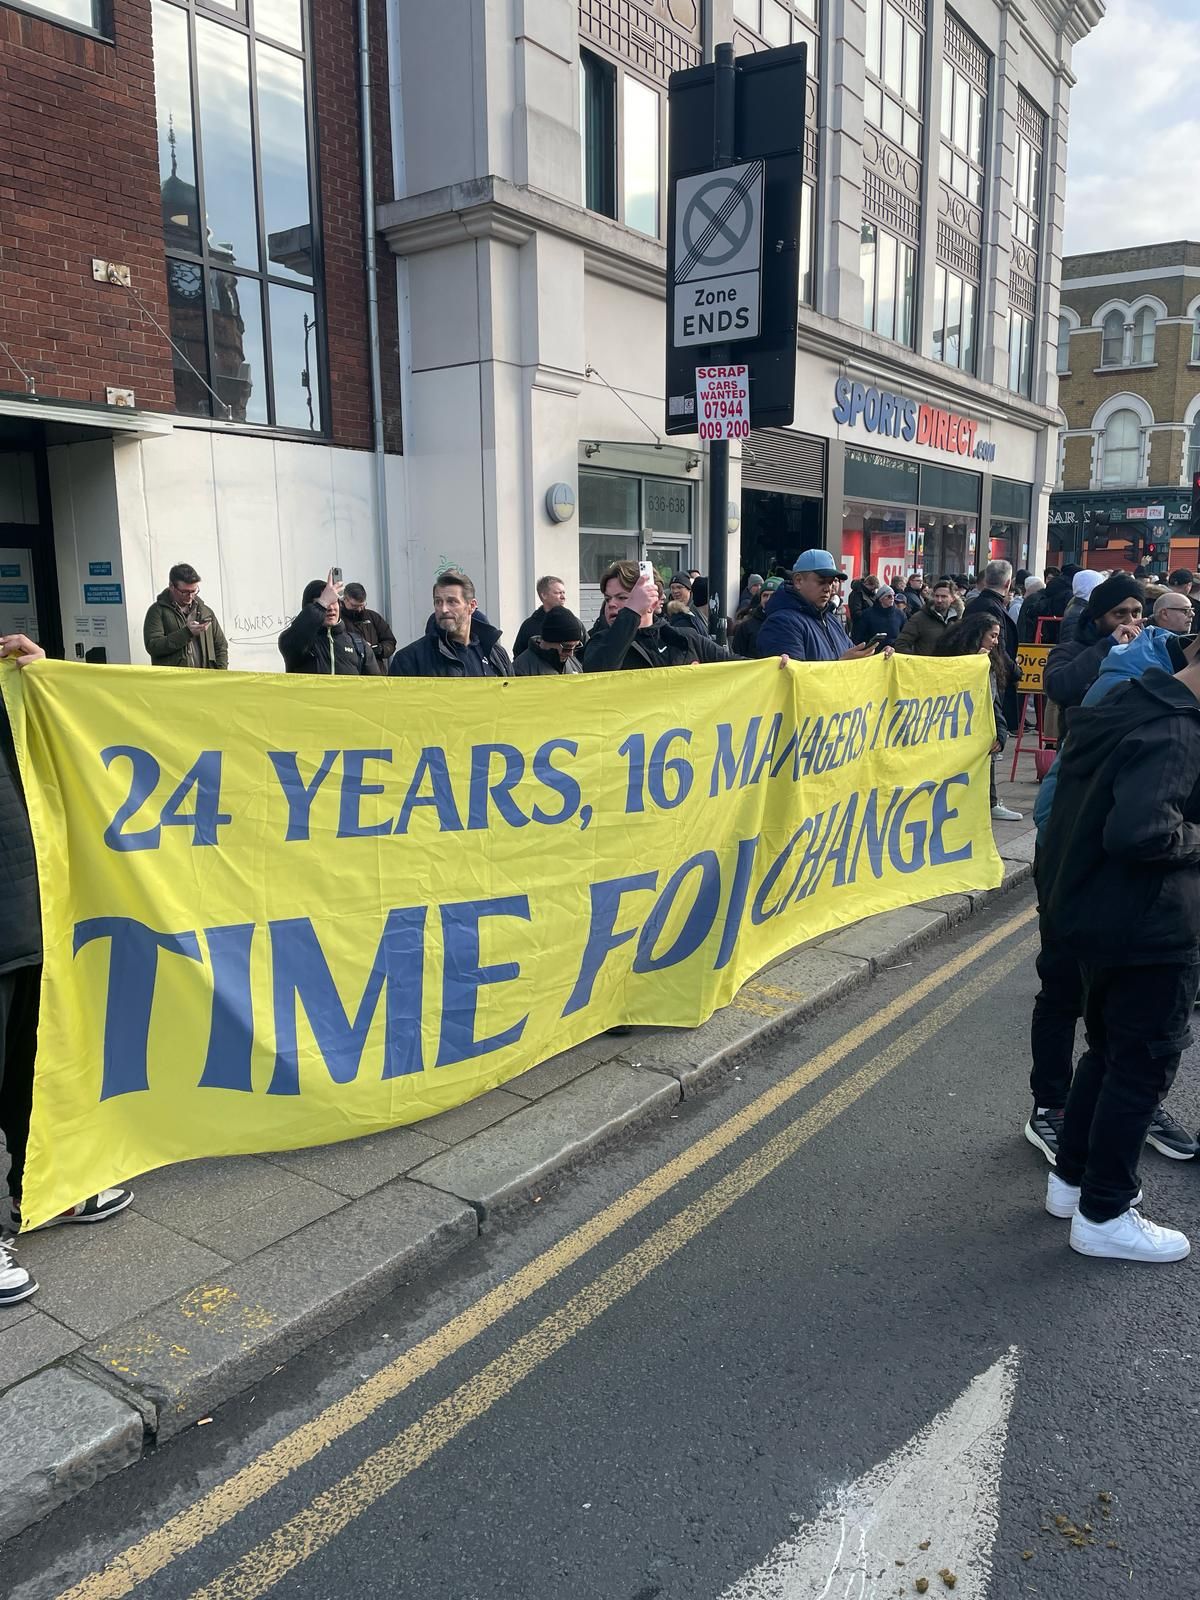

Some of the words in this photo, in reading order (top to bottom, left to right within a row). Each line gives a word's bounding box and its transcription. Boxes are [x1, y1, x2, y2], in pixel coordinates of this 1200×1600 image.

[695, 288, 737, 307] Zone
[683, 307, 750, 337] ENDS
[697, 366, 746, 379] SCRAP
[700, 389, 746, 400] WANTED
[708, 380, 738, 391] CARS
[704, 400, 743, 419] 07944
[700, 421, 722, 440] 009
[727, 419, 749, 438] 200
[648, 495, 685, 513] 636-638
[234, 614, 274, 632] FLOWERS
[1016, 653, 1047, 667] Dive
[1019, 672, 1041, 683] tra
[100, 744, 232, 852] 24
[267, 738, 593, 841] YEARS,
[618, 727, 695, 814] 16
[869, 696, 889, 751] 1
[885, 690, 975, 749] TROPHY
[73, 894, 531, 1102] TIME
[751, 772, 974, 926] CHANGE
